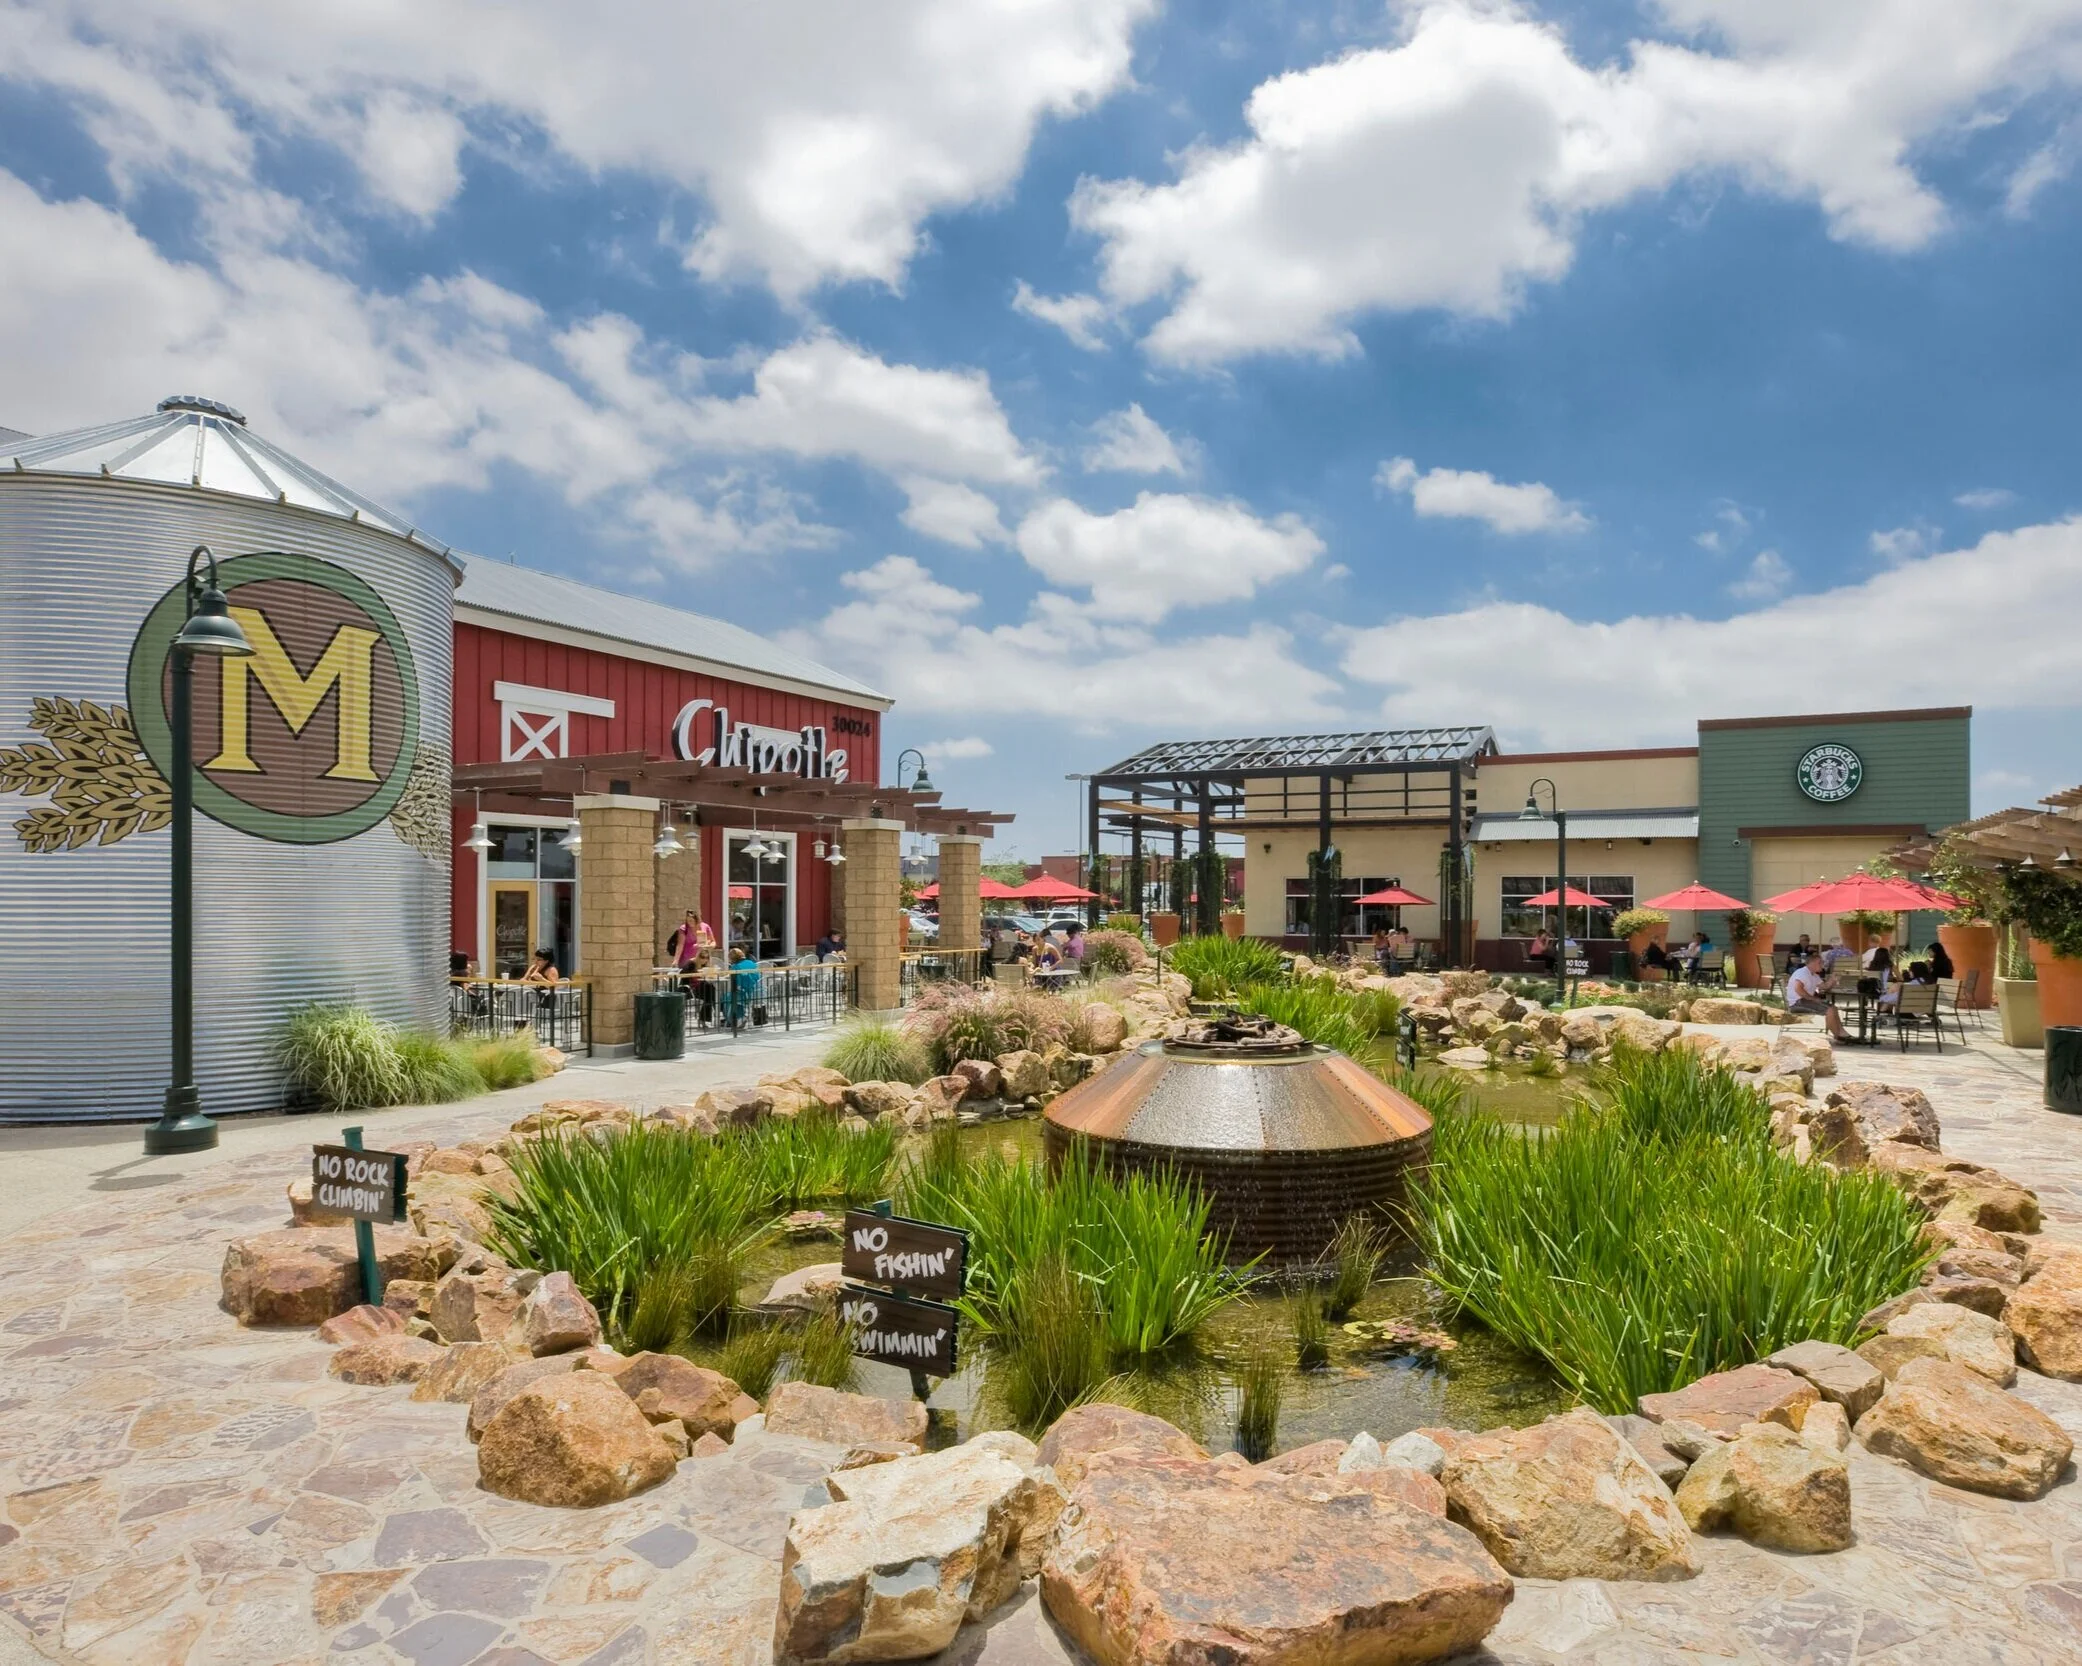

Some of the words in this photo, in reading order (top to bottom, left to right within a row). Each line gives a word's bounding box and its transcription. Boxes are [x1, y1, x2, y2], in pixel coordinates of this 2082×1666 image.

[202, 606, 384, 783] M
[671, 699, 849, 797] Chipotle
[1801, 747, 1858, 773] STARBUCKS
[1808, 784, 1852, 799] COFFEE
[319, 1154, 341, 1178] NO
[344, 1157, 389, 1187] ROCK
[320, 1183, 385, 1213] CLIMBIN'
[853, 1227, 888, 1252] NO
[874, 1247, 954, 1279] FISHIN'
[843, 1300, 878, 1326] NO
